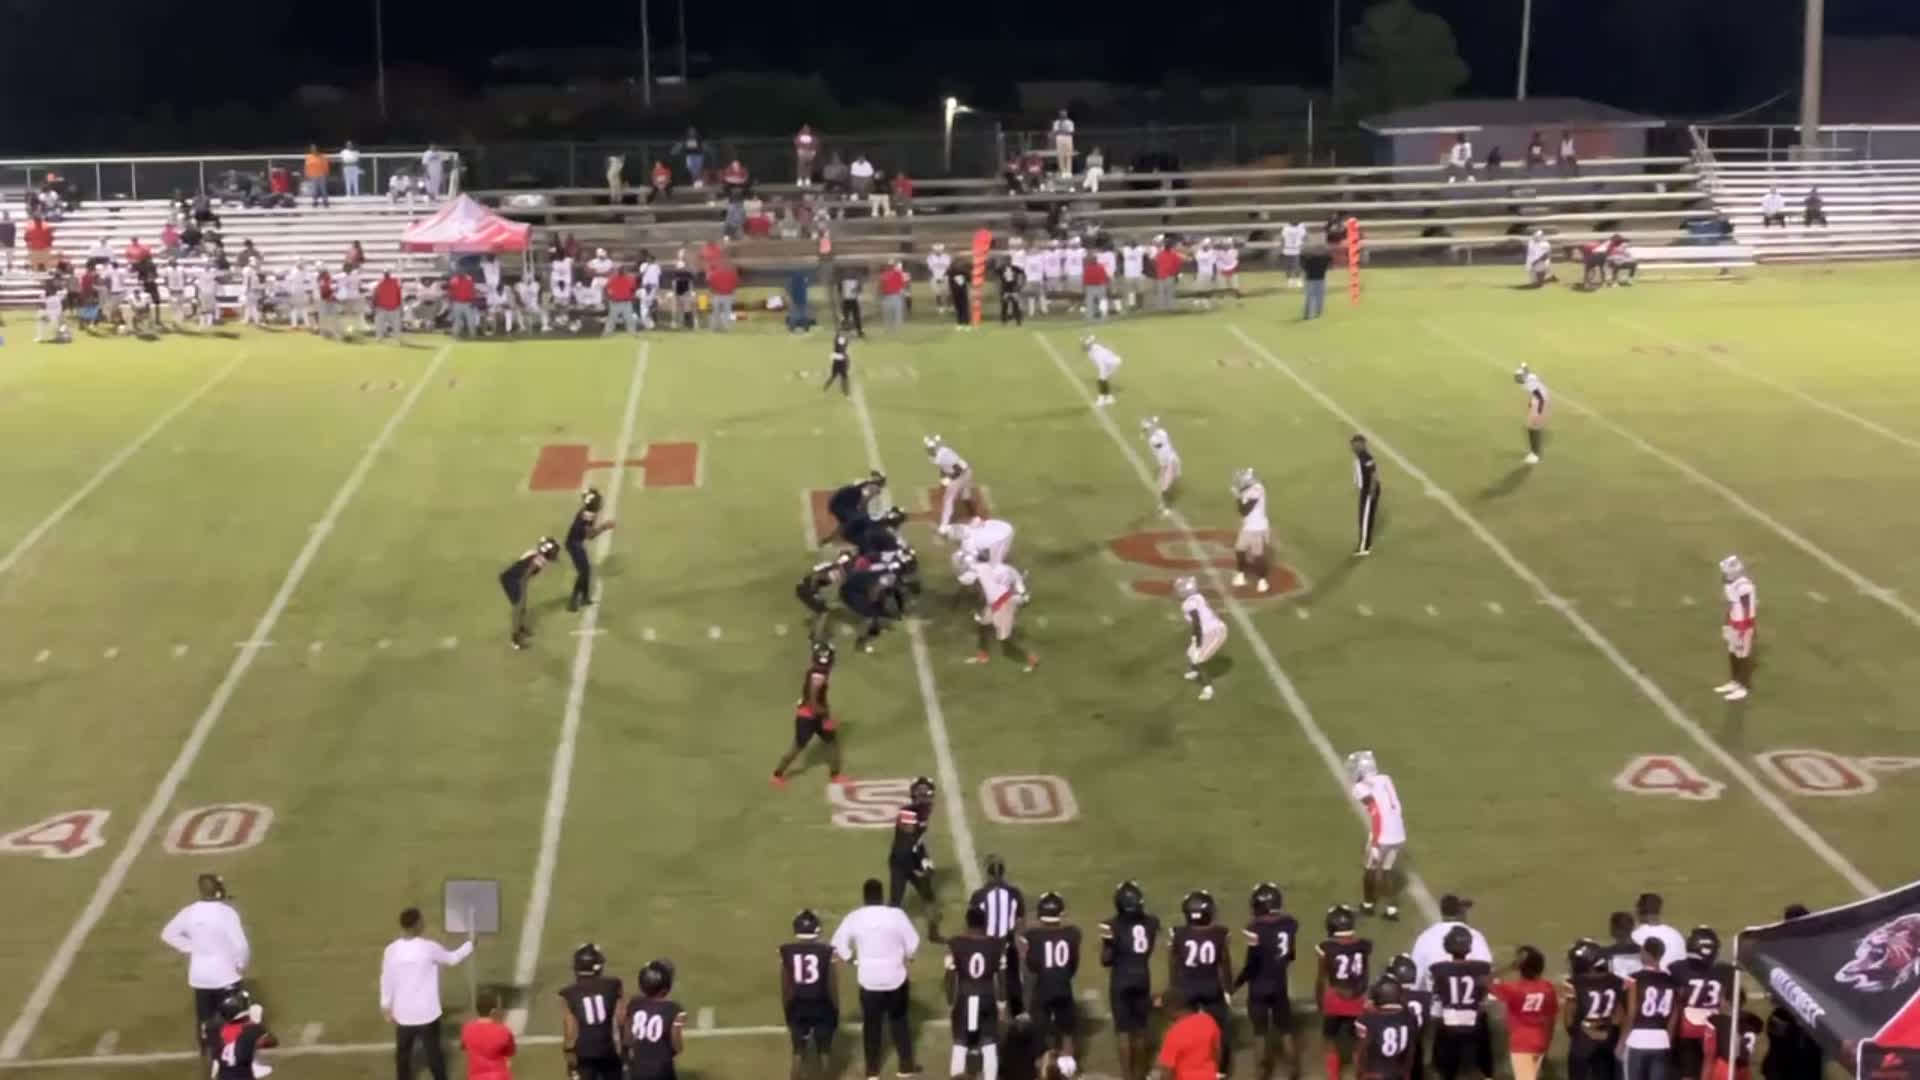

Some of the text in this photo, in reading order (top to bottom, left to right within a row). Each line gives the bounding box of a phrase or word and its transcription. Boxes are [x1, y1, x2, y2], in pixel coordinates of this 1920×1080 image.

[1132, 924, 1148, 953] 8
[1184, 939, 1216, 967] 20
[1277, 931, 1290, 958] 3
[969, 952, 985, 979] 0
[1044, 940, 1069, 968] 10
[793, 954, 819, 984] 13
[1449, 975, 1475, 1005] 12
[1642, 986, 1674, 1017] 84
[1688, 979, 1721, 1008] 73
[582, 994, 606, 1025] 11
[632, 1010, 663, 1043] 80
[1381, 1025, 1408, 1057] 81
